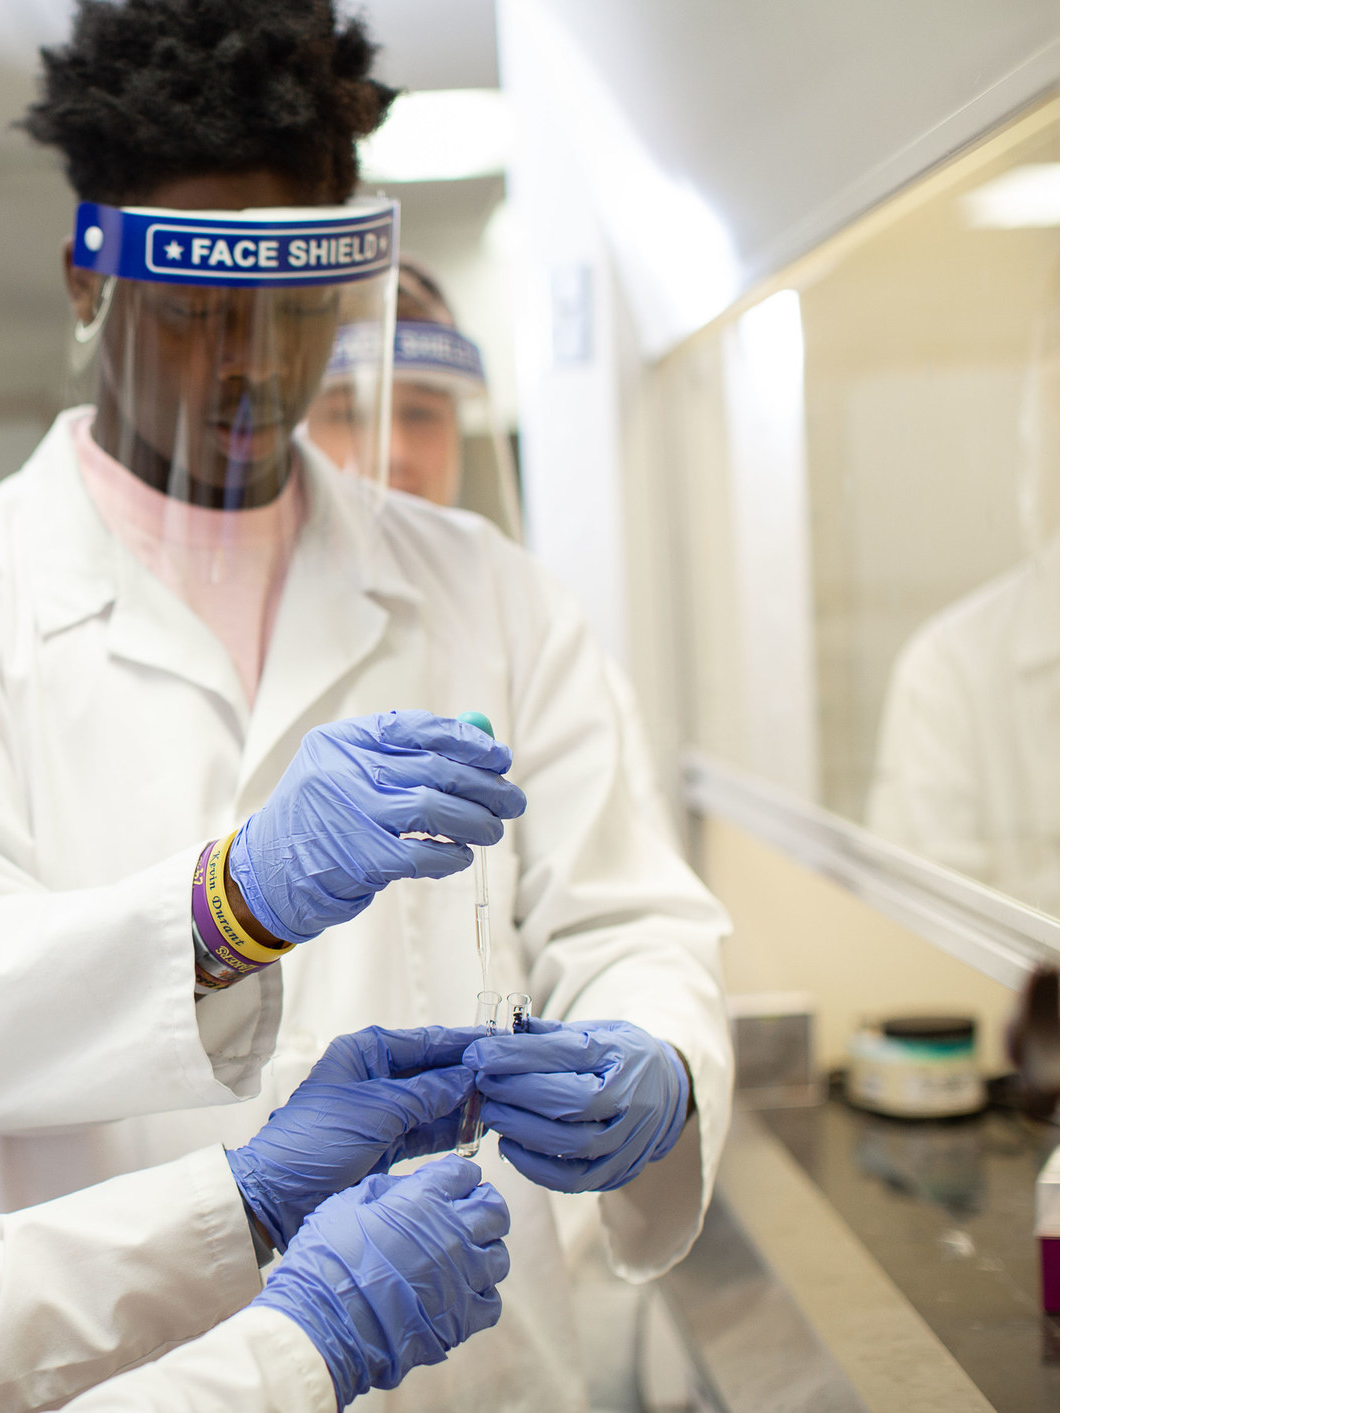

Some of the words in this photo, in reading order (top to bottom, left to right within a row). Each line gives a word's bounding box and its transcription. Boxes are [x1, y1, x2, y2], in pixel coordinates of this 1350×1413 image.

[191, 238, 279, 267] FACE
[288, 233, 377, 267] SHIELD
[209, 850, 221, 890] Kevin
[212, 895, 245, 946] Durant
